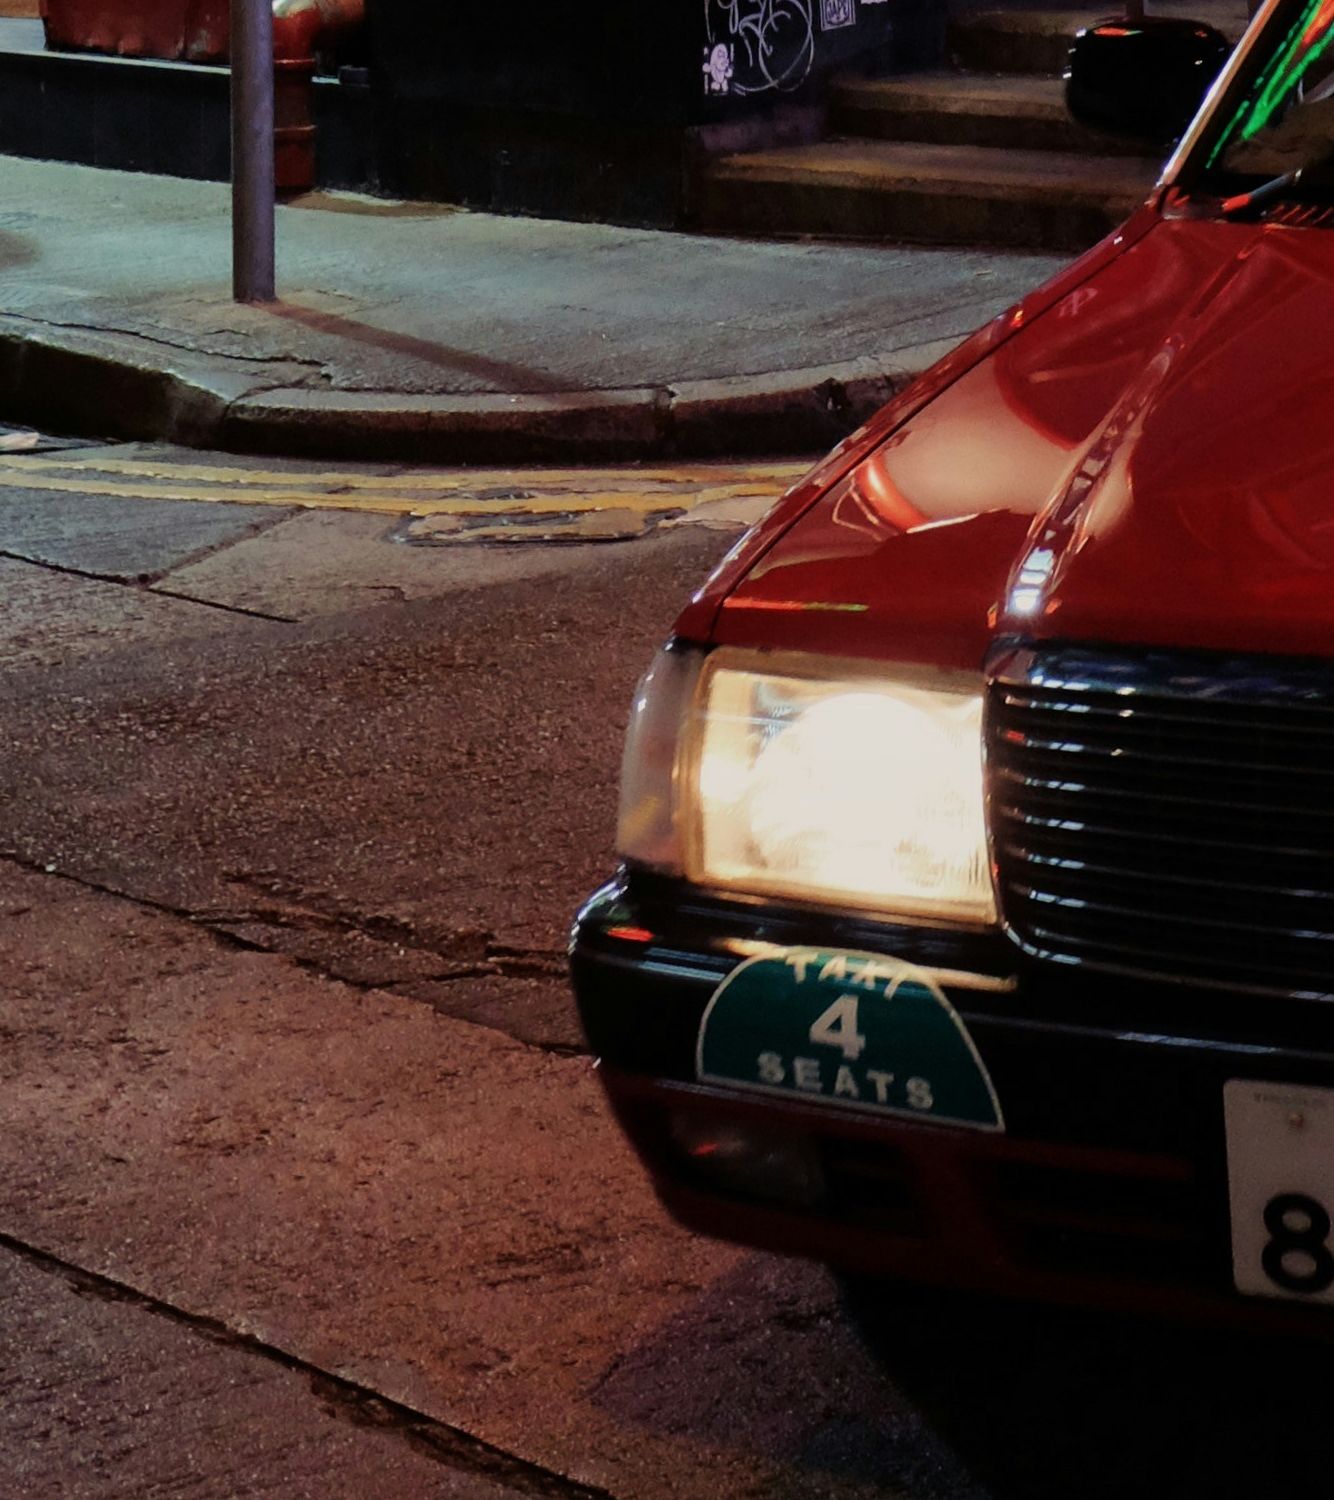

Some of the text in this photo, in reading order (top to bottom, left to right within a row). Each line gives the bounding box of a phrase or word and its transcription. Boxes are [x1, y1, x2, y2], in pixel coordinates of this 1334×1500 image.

[785, 951, 911, 1001] TAXI
[809, 993, 866, 1061] 4
[756, 1051, 935, 1111] SEATS
